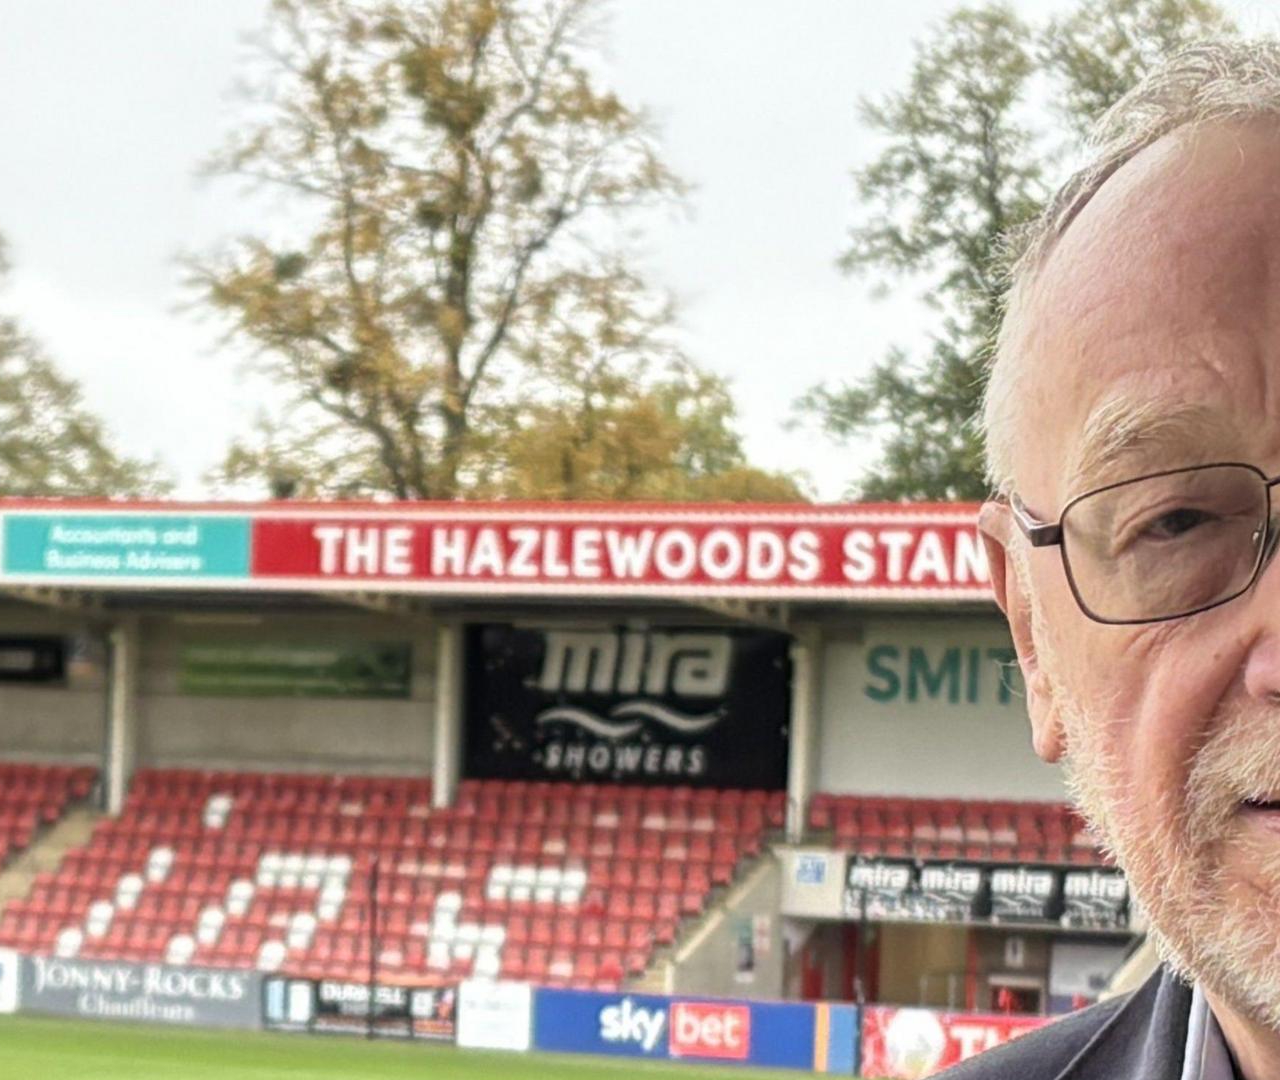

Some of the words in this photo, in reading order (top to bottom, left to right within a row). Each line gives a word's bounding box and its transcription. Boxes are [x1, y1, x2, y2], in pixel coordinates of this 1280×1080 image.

[52, 525, 158, 545] Accountants
[163, 525, 199, 546] and
[313, 526, 413, 575] THE
[430, 528, 823, 582] HAZLEWOODS
[537, 630, 732, 696] mira
[545, 744, 706, 774] SHOWERS
[921, 866, 981, 896] mira
[991, 867, 1054, 898] mira
[33, 956, 244, 1000] JONNY-ROCKS
[601, 998, 663, 1047] sky
[675, 1007, 741, 1045] bet
